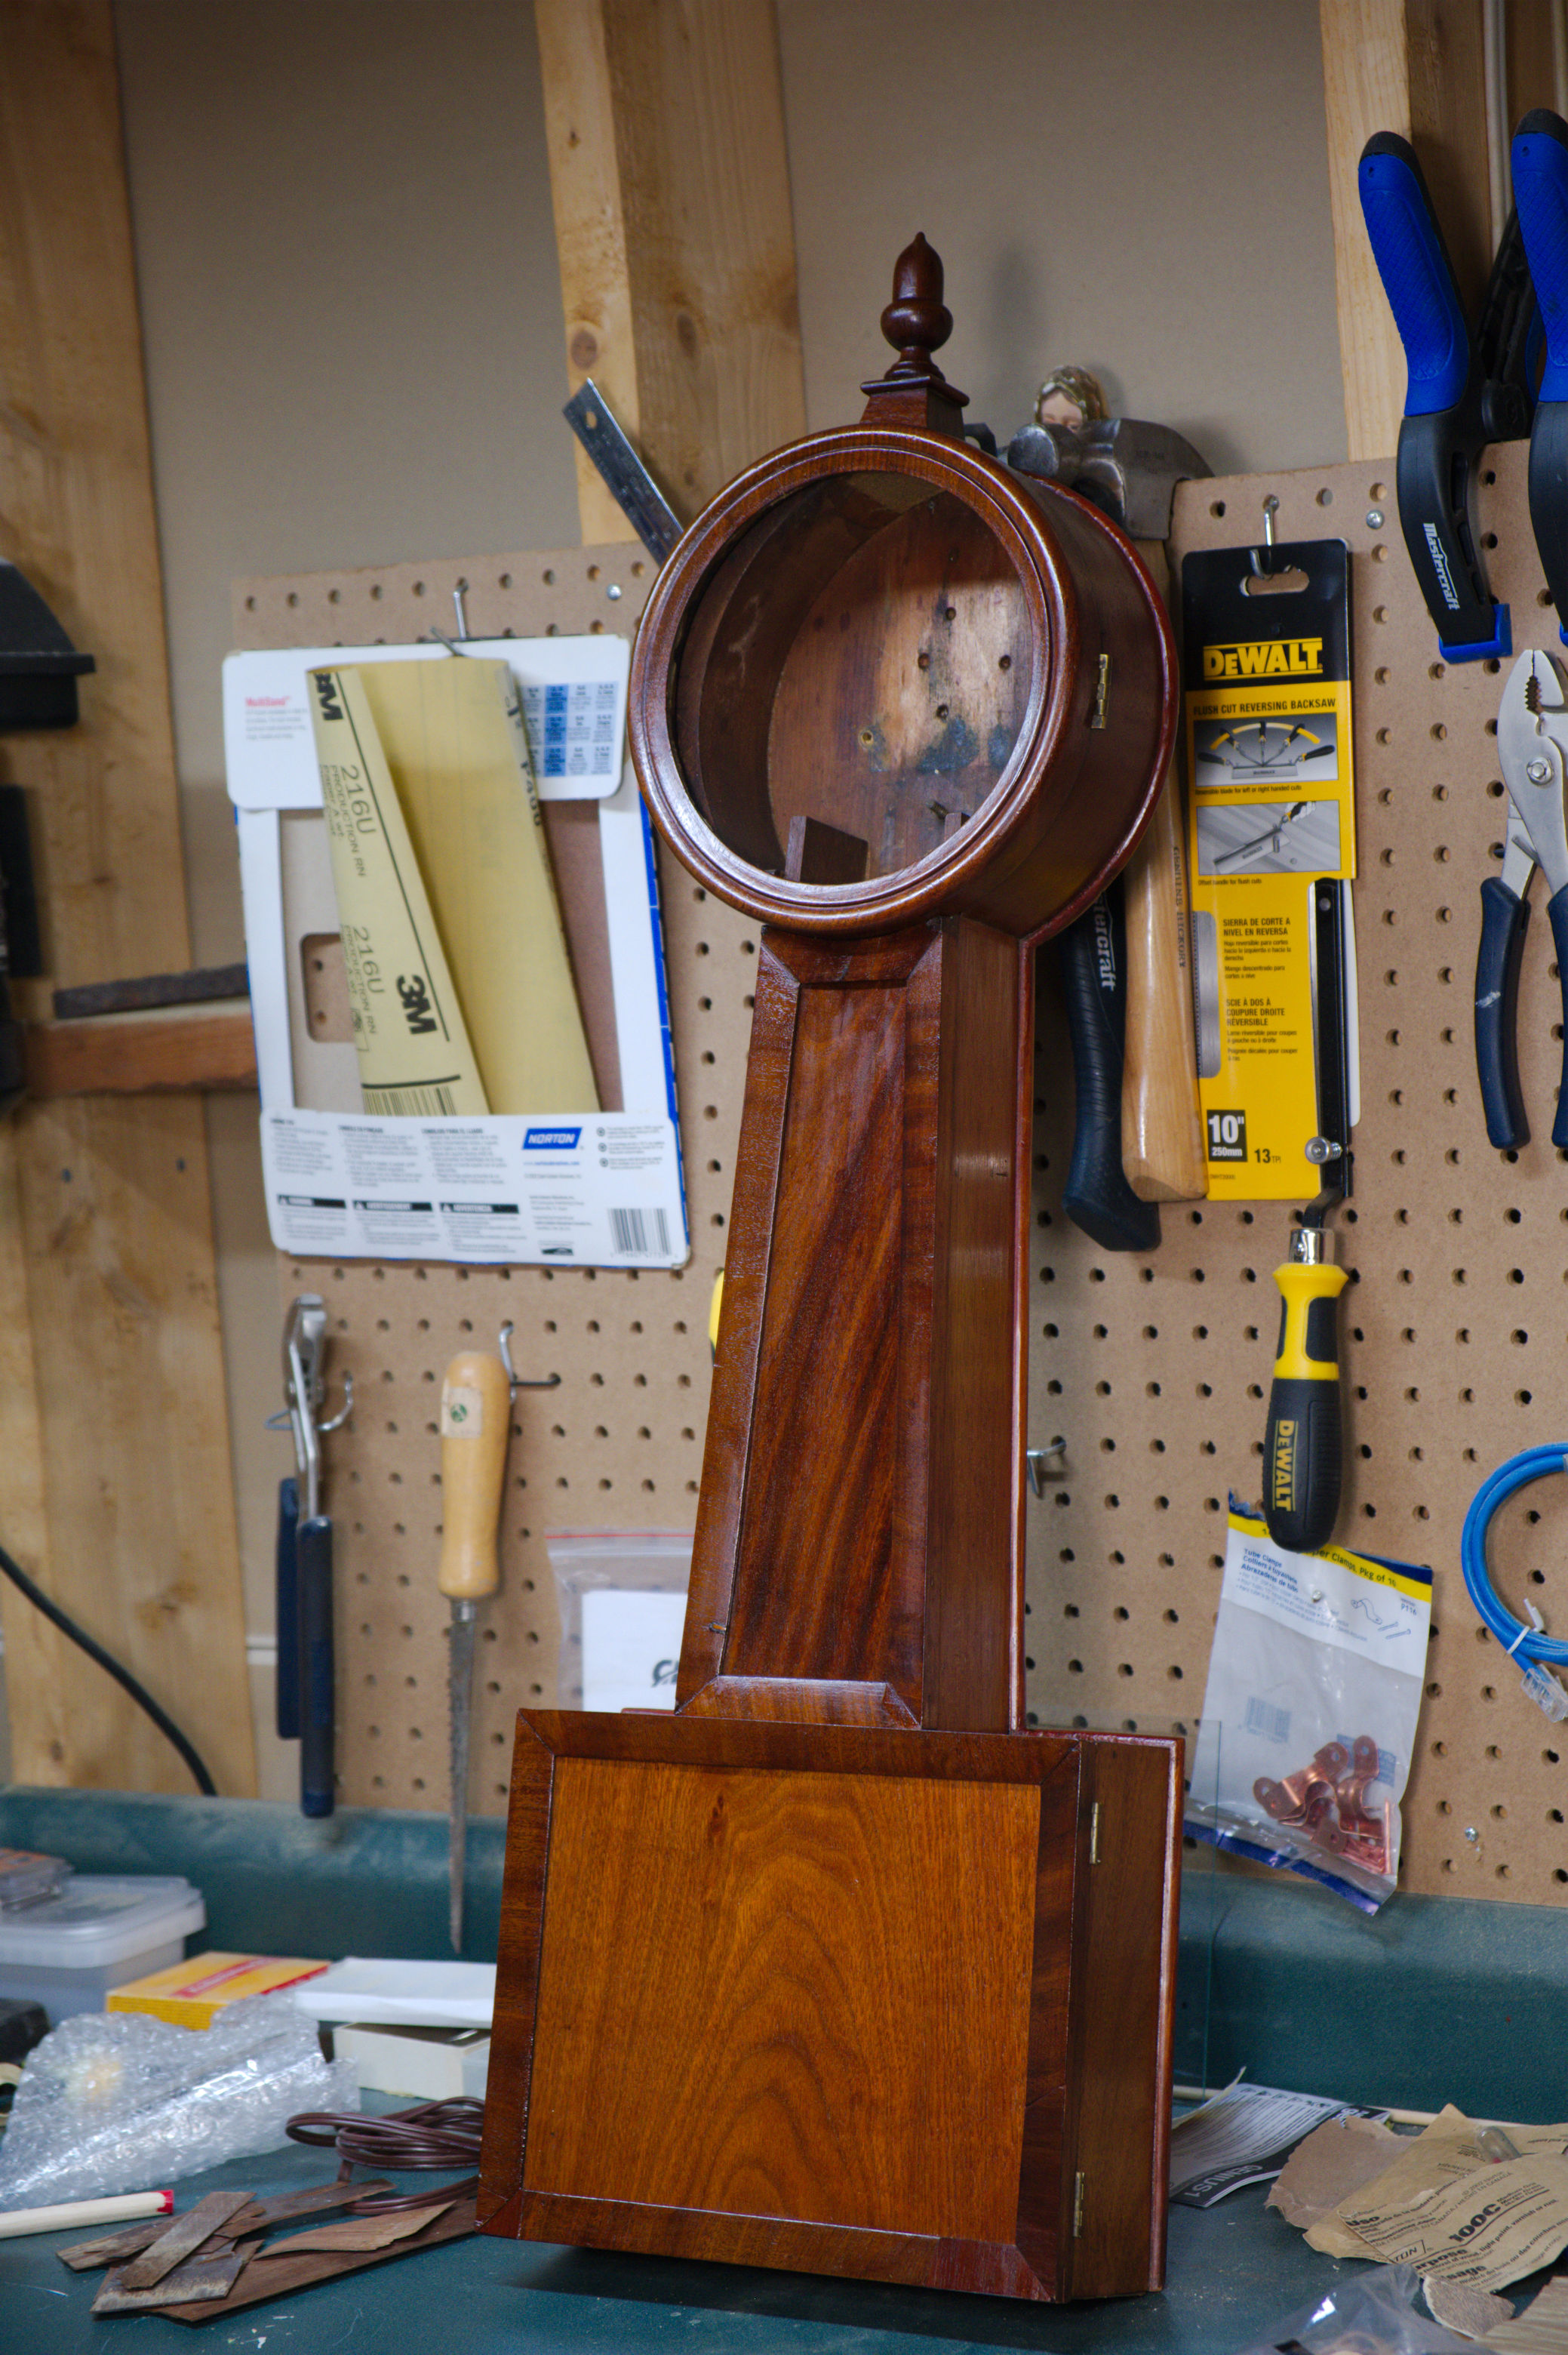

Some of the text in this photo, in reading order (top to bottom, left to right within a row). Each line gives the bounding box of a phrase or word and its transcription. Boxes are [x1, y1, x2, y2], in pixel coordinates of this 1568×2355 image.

[1194, 698, 1336, 716] FLUSH CUT REVERSING BACKSAW
[341, 765, 376, 834] 216U
[331, 765, 359, 853] PRODUCTION
[1222, 918, 1248, 926] SIERRA
[1261, 917, 1283, 925] CORTE
[1095, 898, 1117, 992] tercraft
[352, 926, 385, 994] 216U
[395, 974, 438, 1035] 3M
[1250, 998, 1264, 1006] DOS
[1227, 1008, 1285, 1016] COUPURE DROITE
[528, 1133, 576, 1144] NORTON
[1211, 1147, 1243, 1157] 250mm
[1254, 1148, 1281, 1164] 13 TPI
[1275, 1420, 1295, 1512] DEWALT
[1244, 1547, 1282, 1568] Tube Clamps
[1360, 1567, 1374, 1581] Pkg
[1448, 2203, 1502, 2243] 100C
[1395, 2246, 1418, 2261] TON
